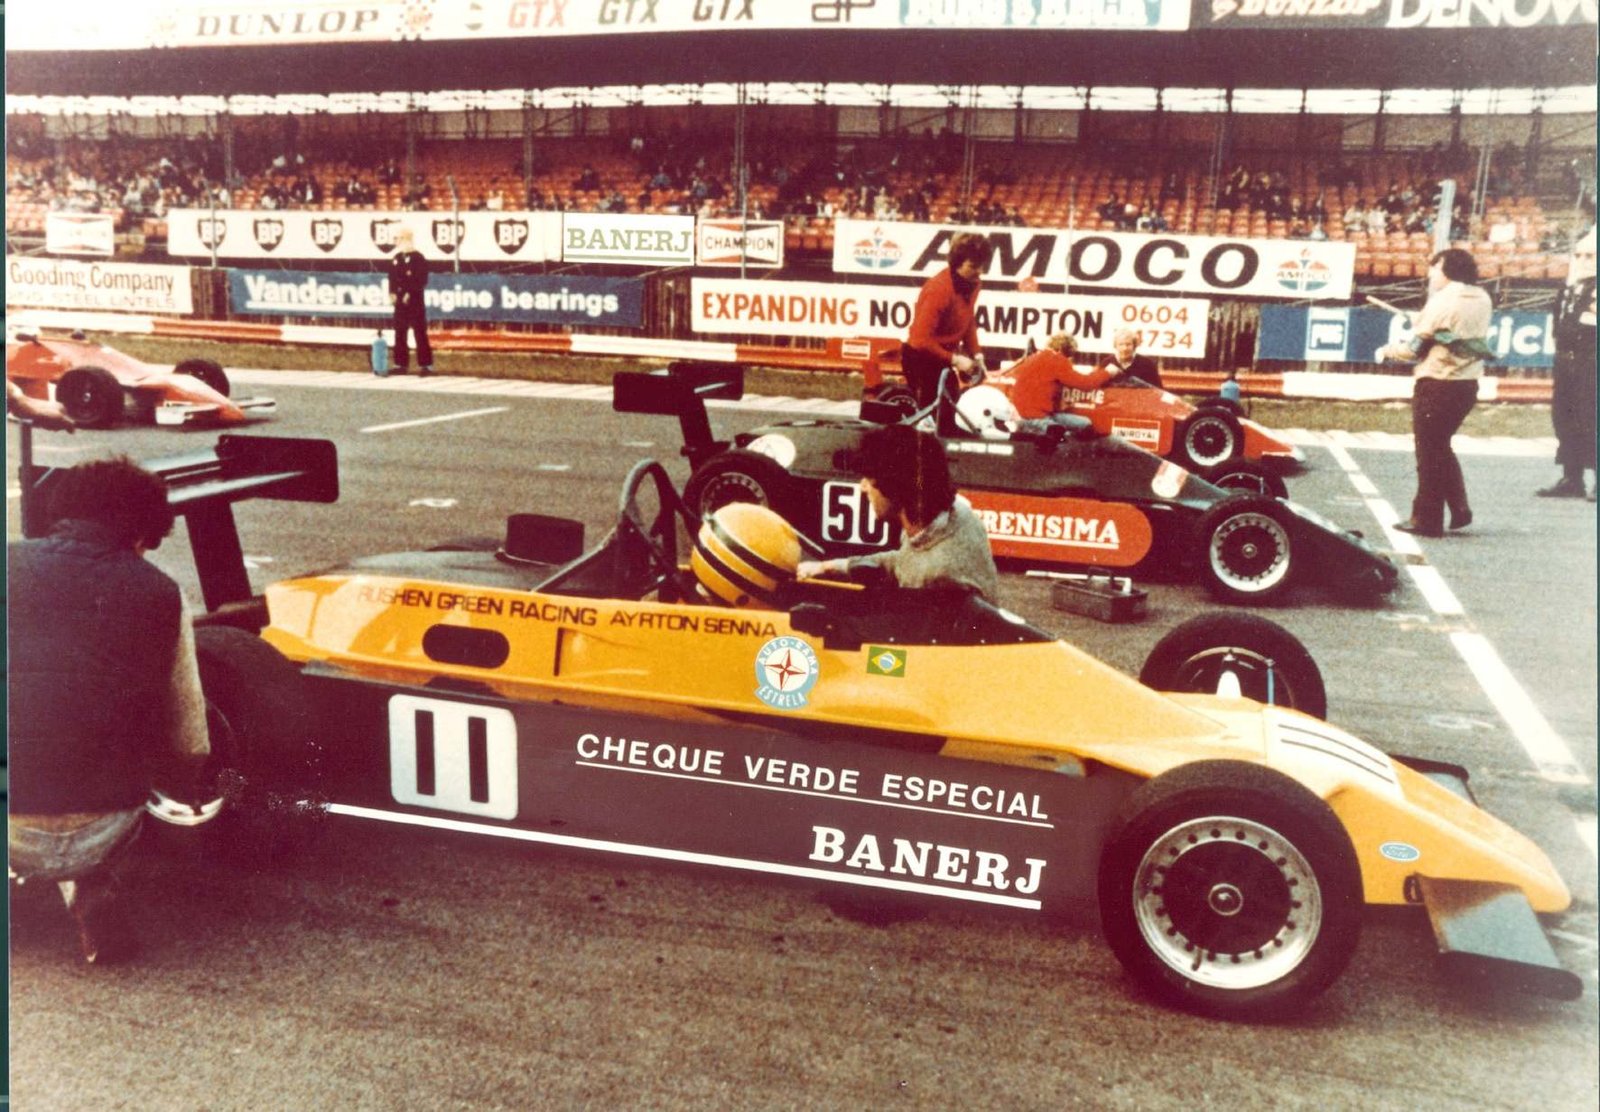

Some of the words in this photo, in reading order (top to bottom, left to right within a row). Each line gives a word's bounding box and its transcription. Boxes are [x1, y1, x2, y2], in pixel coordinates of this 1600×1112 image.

[196, 9, 380, 37] DUNLOP
[507, 0, 567, 28] GTX
[598, 0, 659, 25] GTX
[257, 223, 283, 245] BP
[314, 222, 342, 245] BP
[498, 223, 527, 246] BP
[567, 227, 692, 253] BANERJ
[704, 236, 775, 251] CHAMPION
[10, 262, 86, 290] Gooding
[90, 265, 174, 295] Company
[244, 274, 391, 303] Vandervel
[423, 284, 494, 312] ngine
[501, 285, 619, 317] bearings
[702, 292, 859, 326] EXPANDING
[869, 300, 1103, 340] NOAMPTON
[1121, 304, 1189, 325] 0604
[828, 485, 884, 544] 50
[972, 509, 1120, 544] RENISIMA
[357, 586, 433, 608] RUSHEN
[436, 593, 504, 615] GREEN
[510, 600, 598, 628] RACING
[609, 609, 700, 633] AYRTON
[703, 617, 778, 637] SENNA
[757, 685, 808, 708] ESTRELA
[576, 733, 724, 777] CHEQUE
[744, 755, 861, 794] VERDE
[881, 773, 1050, 820] ESPECIAL
[808, 826, 1047, 895] BANERJ
